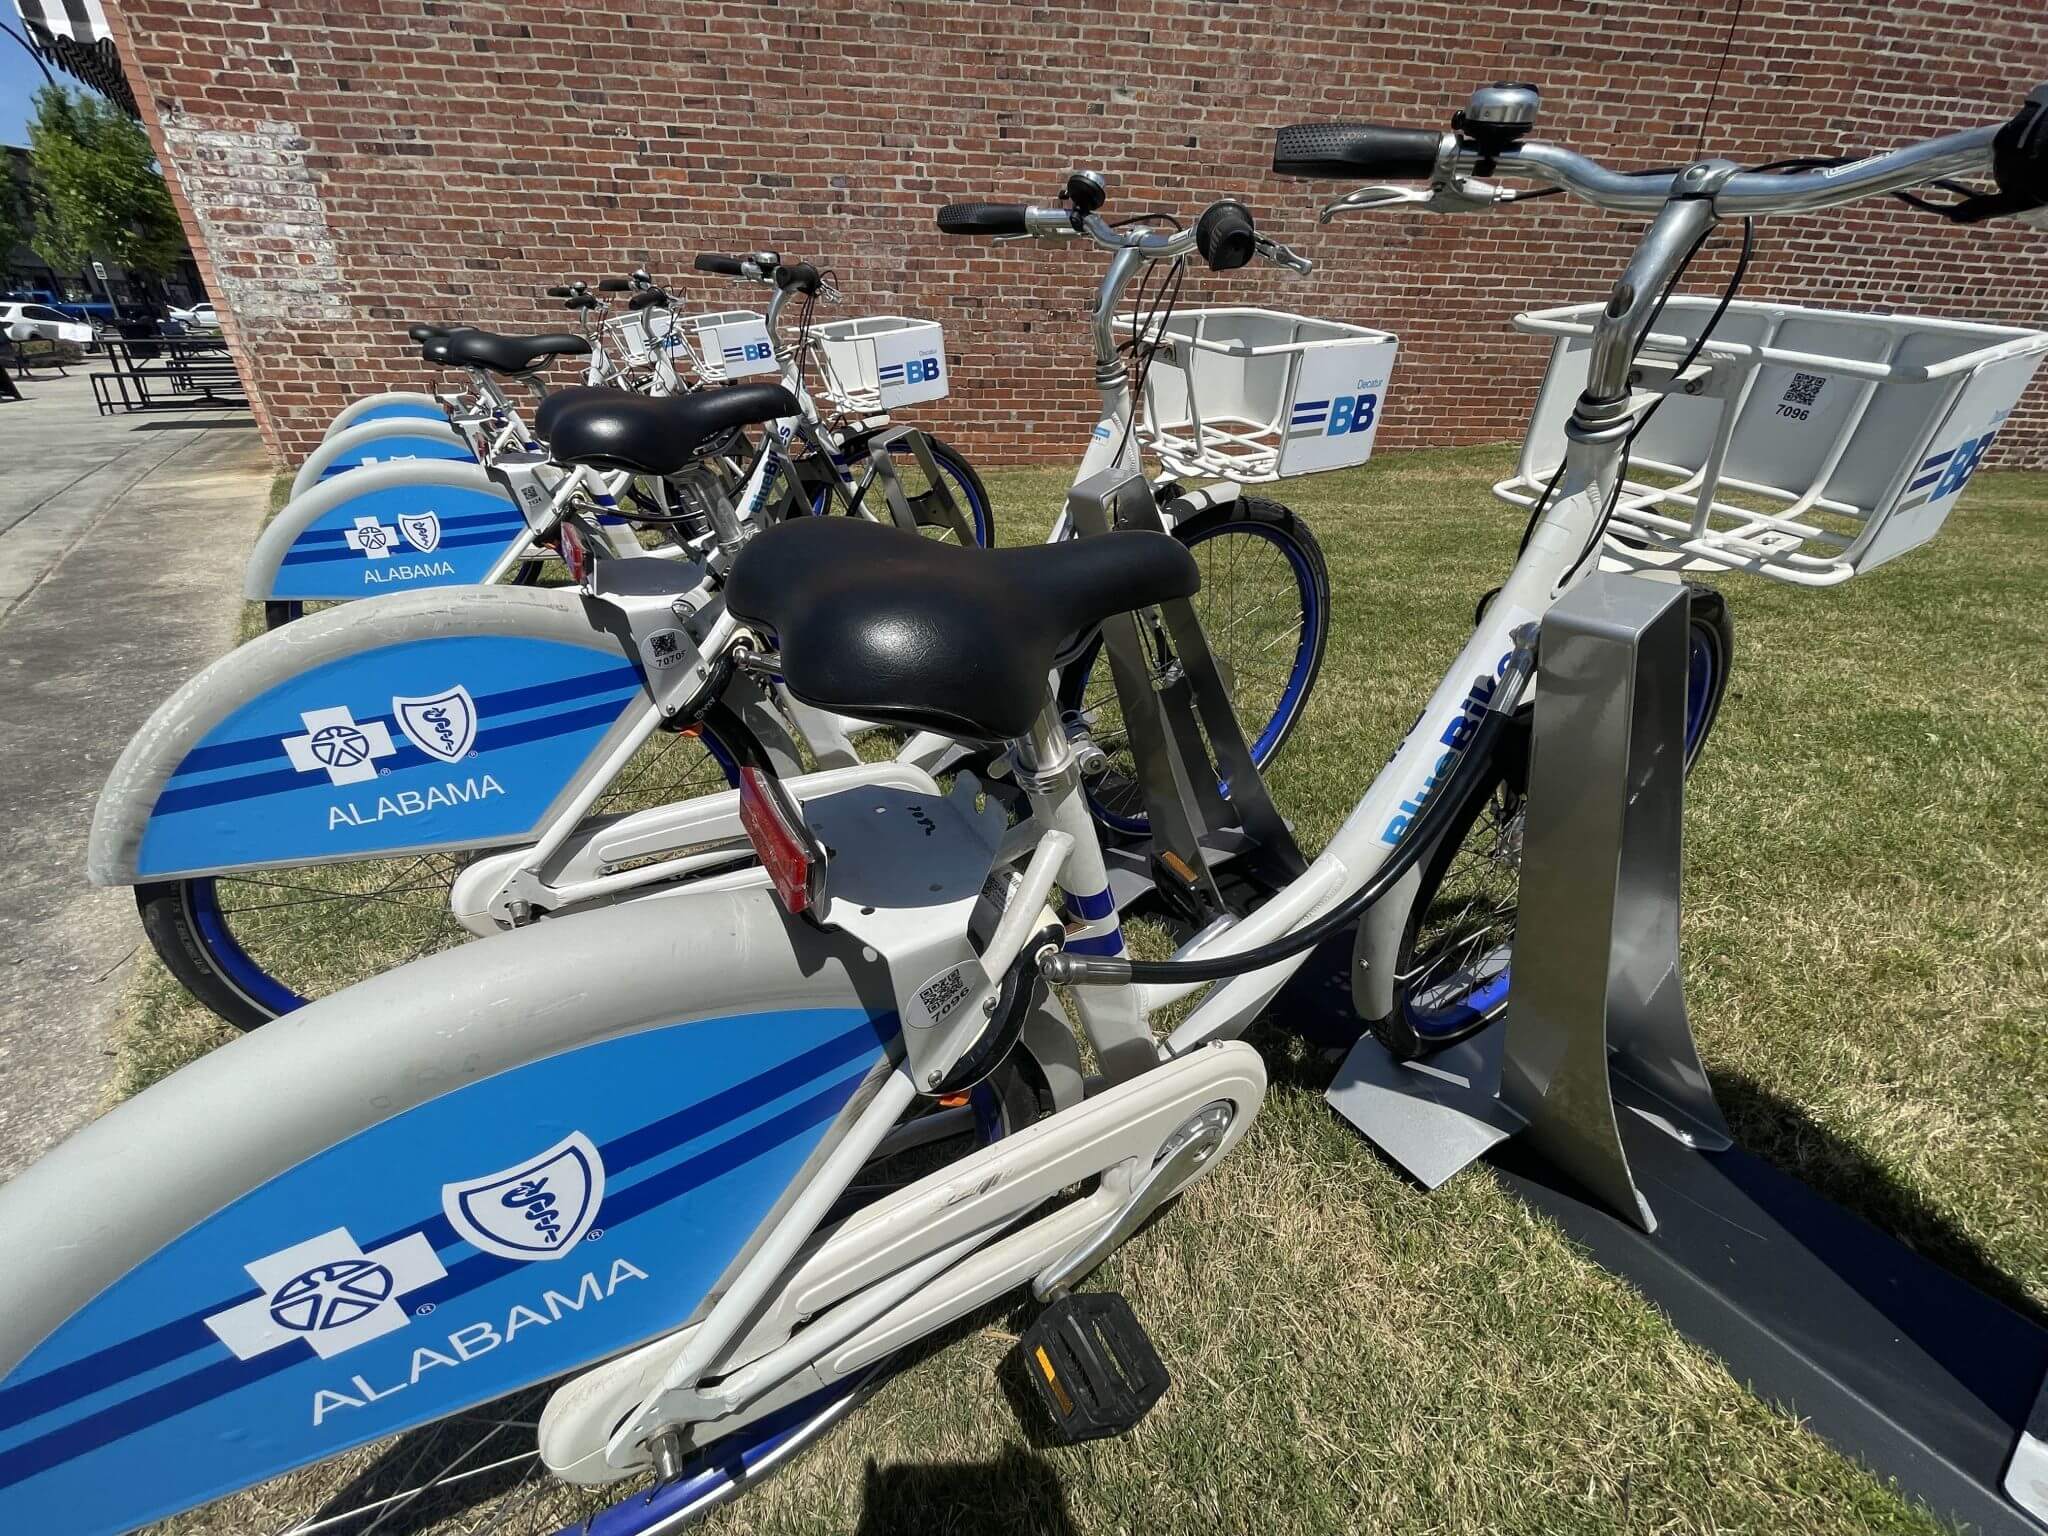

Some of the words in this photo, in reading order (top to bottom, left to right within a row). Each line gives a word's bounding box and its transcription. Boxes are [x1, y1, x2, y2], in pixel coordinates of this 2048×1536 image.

[744, 343, 772, 361] BB
[906, 358, 939, 384] BB
[1357, 378, 1384, 390] Decatur
[1327, 393, 1378, 436] BB
[1775, 404, 1810, 421] 7096
[1928, 430, 1997, 503] BB
[364, 561, 455, 585] ALABAMA
[328, 774, 505, 831] ALABAMA
[930, 986, 970, 1023] 7096
[313, 1257, 649, 1426] ALABAMA
